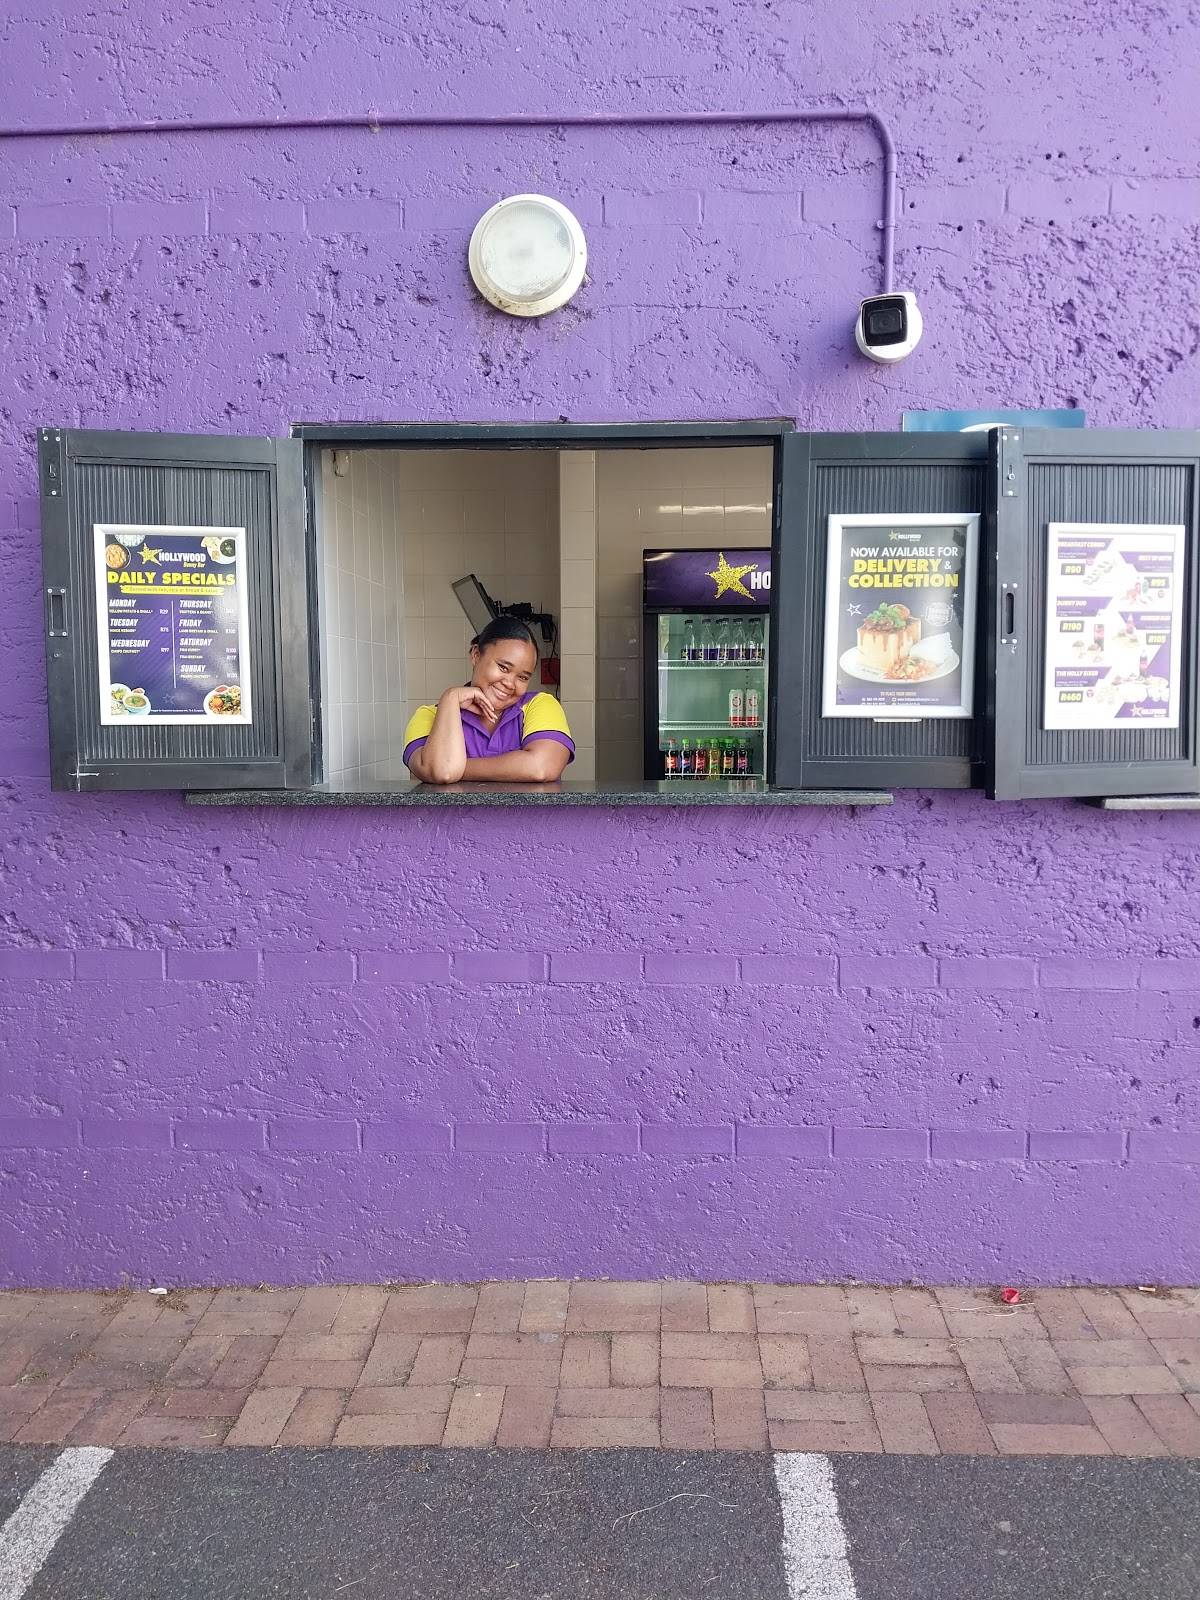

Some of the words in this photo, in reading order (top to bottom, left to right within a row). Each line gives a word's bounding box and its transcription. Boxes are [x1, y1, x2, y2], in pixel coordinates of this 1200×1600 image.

[850, 547, 879, 557] NOW
[881, 547, 935, 557] AVAILABLE
[937, 546, 958, 557] FOR
[158, 552, 206, 562] HOLLYWOOD
[854, 558, 943, 573] DELIVERY
[944, 560, 952, 570] &
[107, 571, 157, 584] DAILY
[162, 572, 236, 586] SPECIALS
[751, 571, 771, 589] HO
[848, 573, 959, 588] COLLECTION
[109, 599, 137, 607] MONDAY
[179, 600, 213, 608] THURSDAY
[110, 618, 139, 627] TUESDAY
[179, 619, 202, 627] FRIDAY
[111, 639, 151, 648] WEDNESDAY
[179, 638, 213, 646] SATURDAY
[180, 664, 206, 672] SUNDAY
